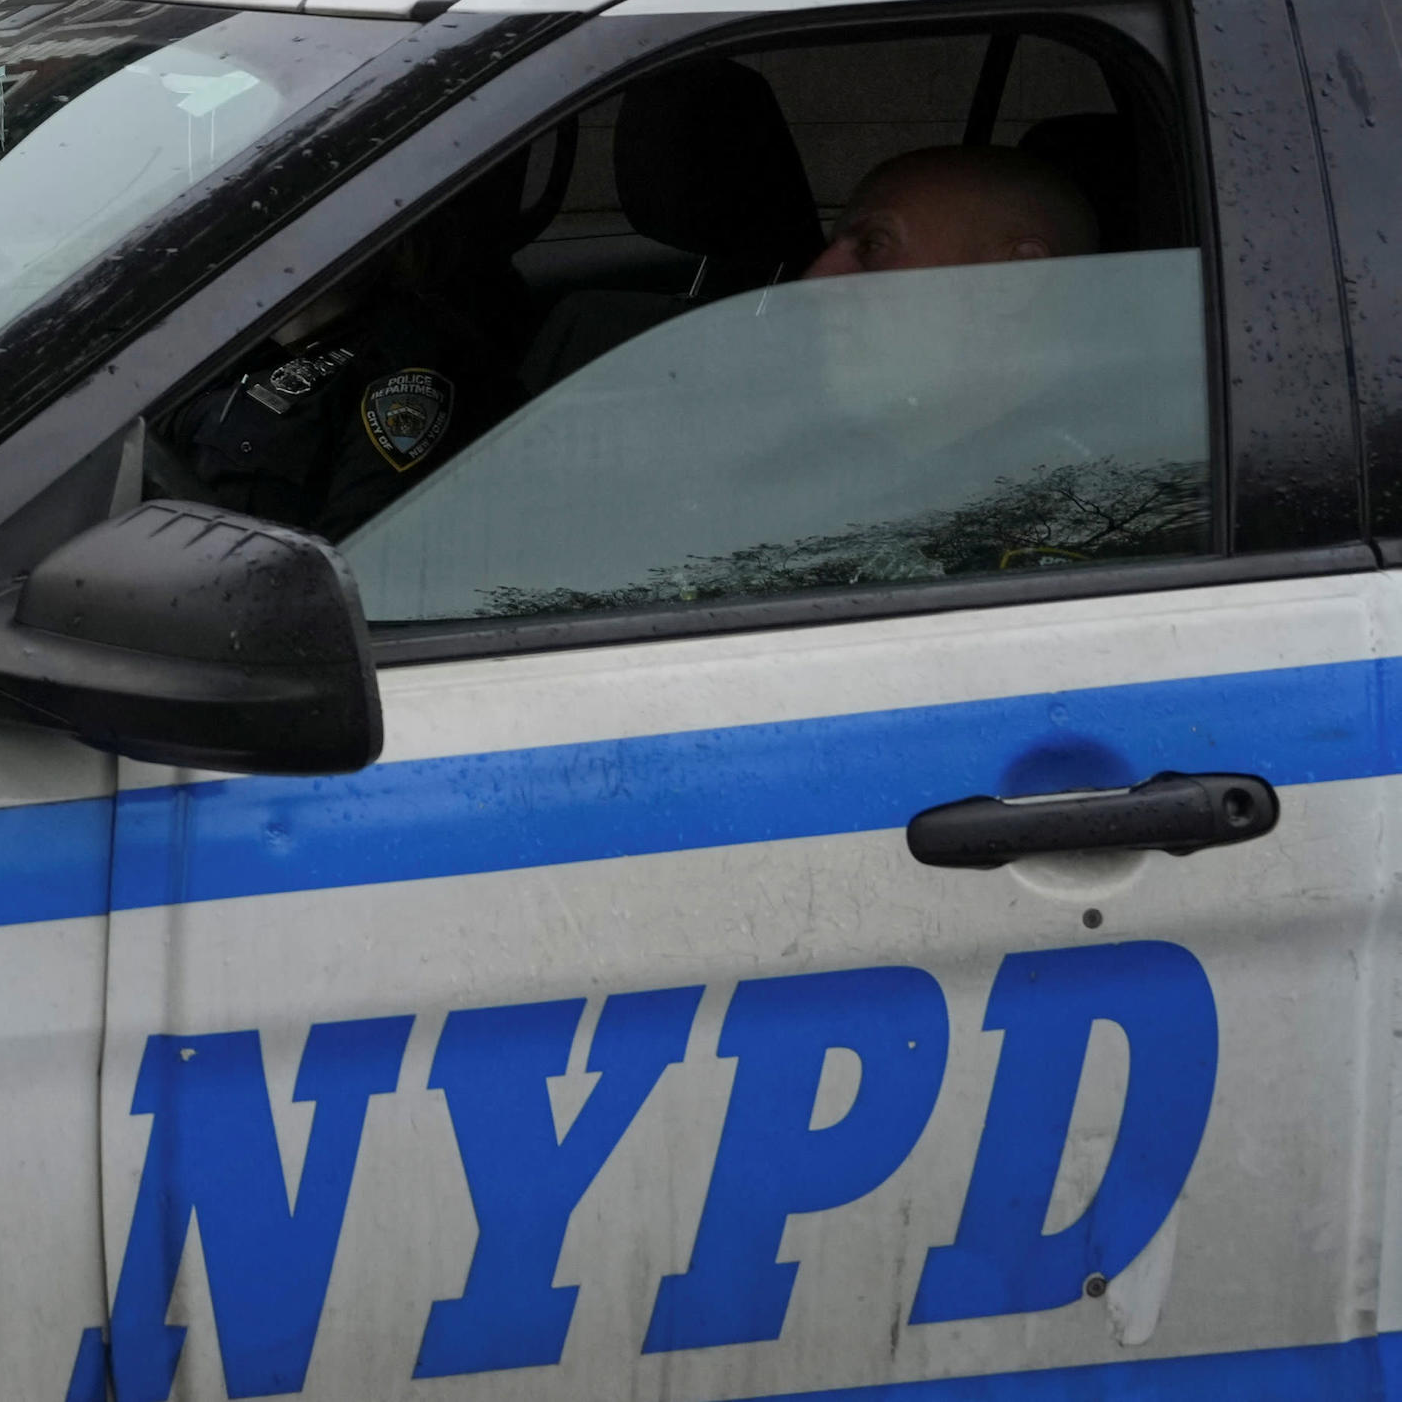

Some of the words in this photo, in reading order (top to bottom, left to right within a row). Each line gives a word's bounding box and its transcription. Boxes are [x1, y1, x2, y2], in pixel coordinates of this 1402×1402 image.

[387, 374, 433, 387] POLICE
[366, 410, 383, 436] CITY
[378, 435, 394, 453] OF
[408, 437, 431, 459] NEW
[64, 939, 1220, 1402] NYPD
